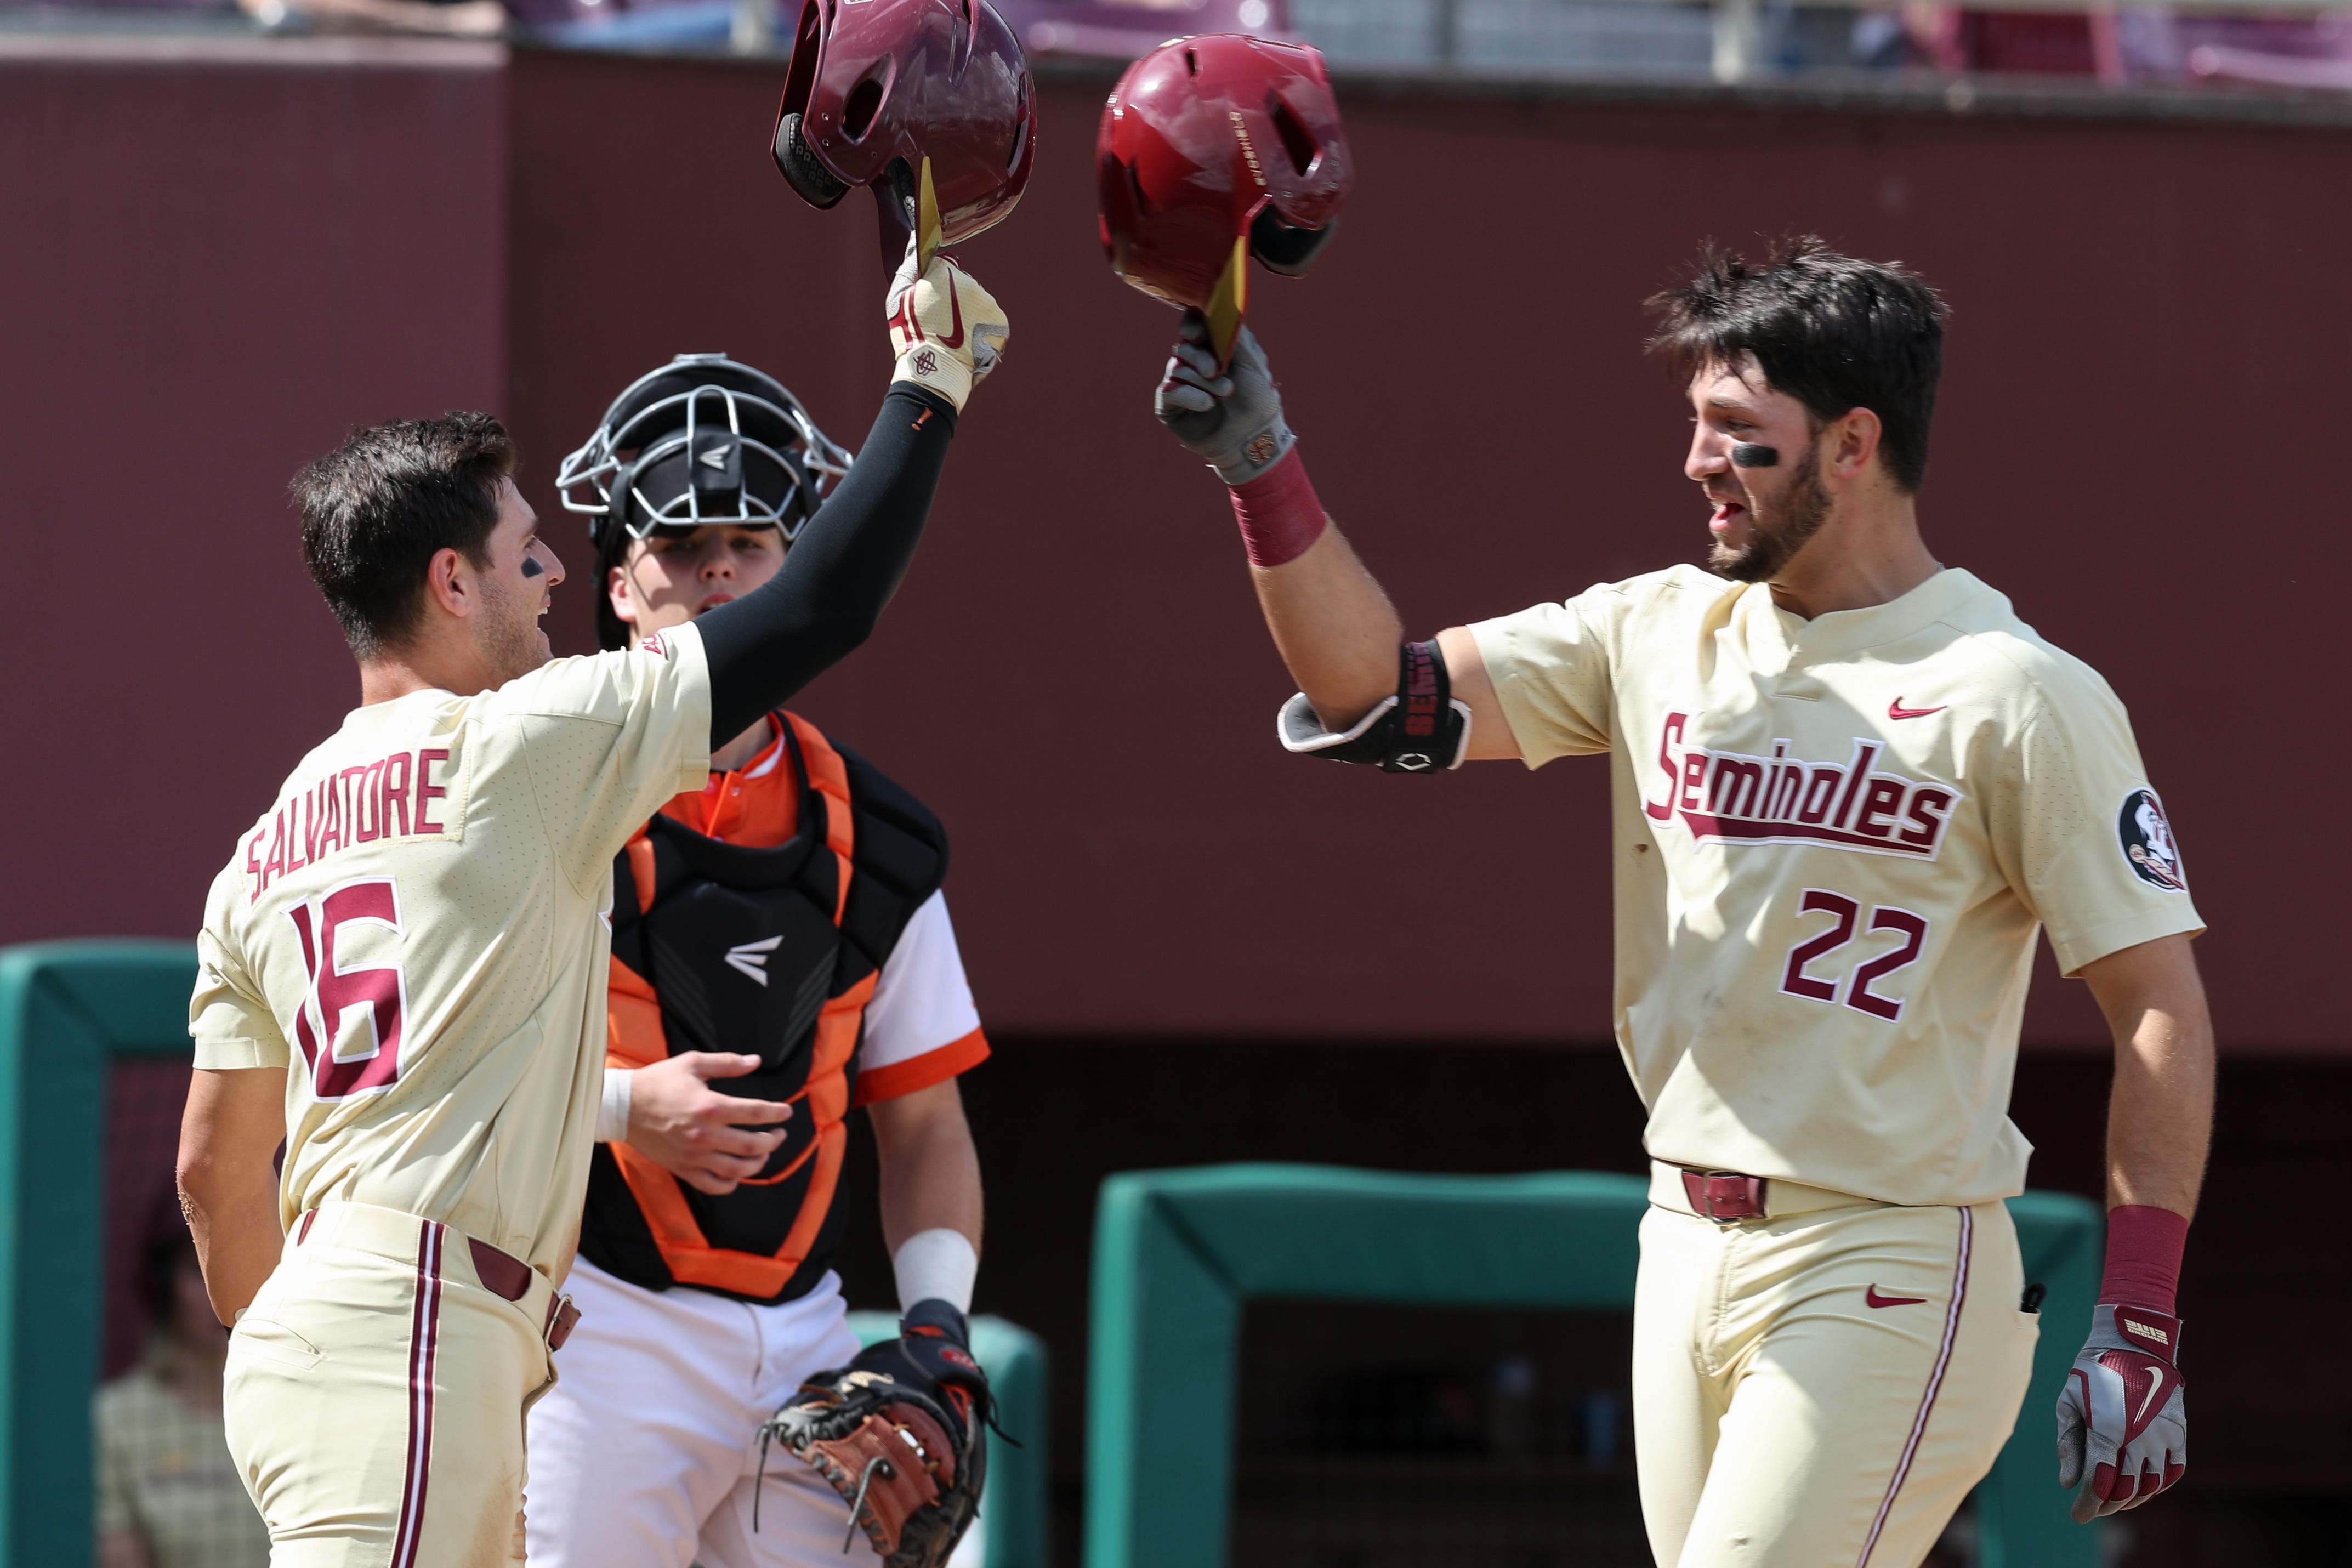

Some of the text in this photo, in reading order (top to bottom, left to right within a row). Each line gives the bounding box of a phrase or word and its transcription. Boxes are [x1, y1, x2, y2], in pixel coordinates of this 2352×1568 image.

[247, 748, 449, 907] SALVATORE
[1642, 709, 1965, 861] Seminoles
[280, 875, 407, 1103] 16
[1778, 888, 1930, 1024] 22
